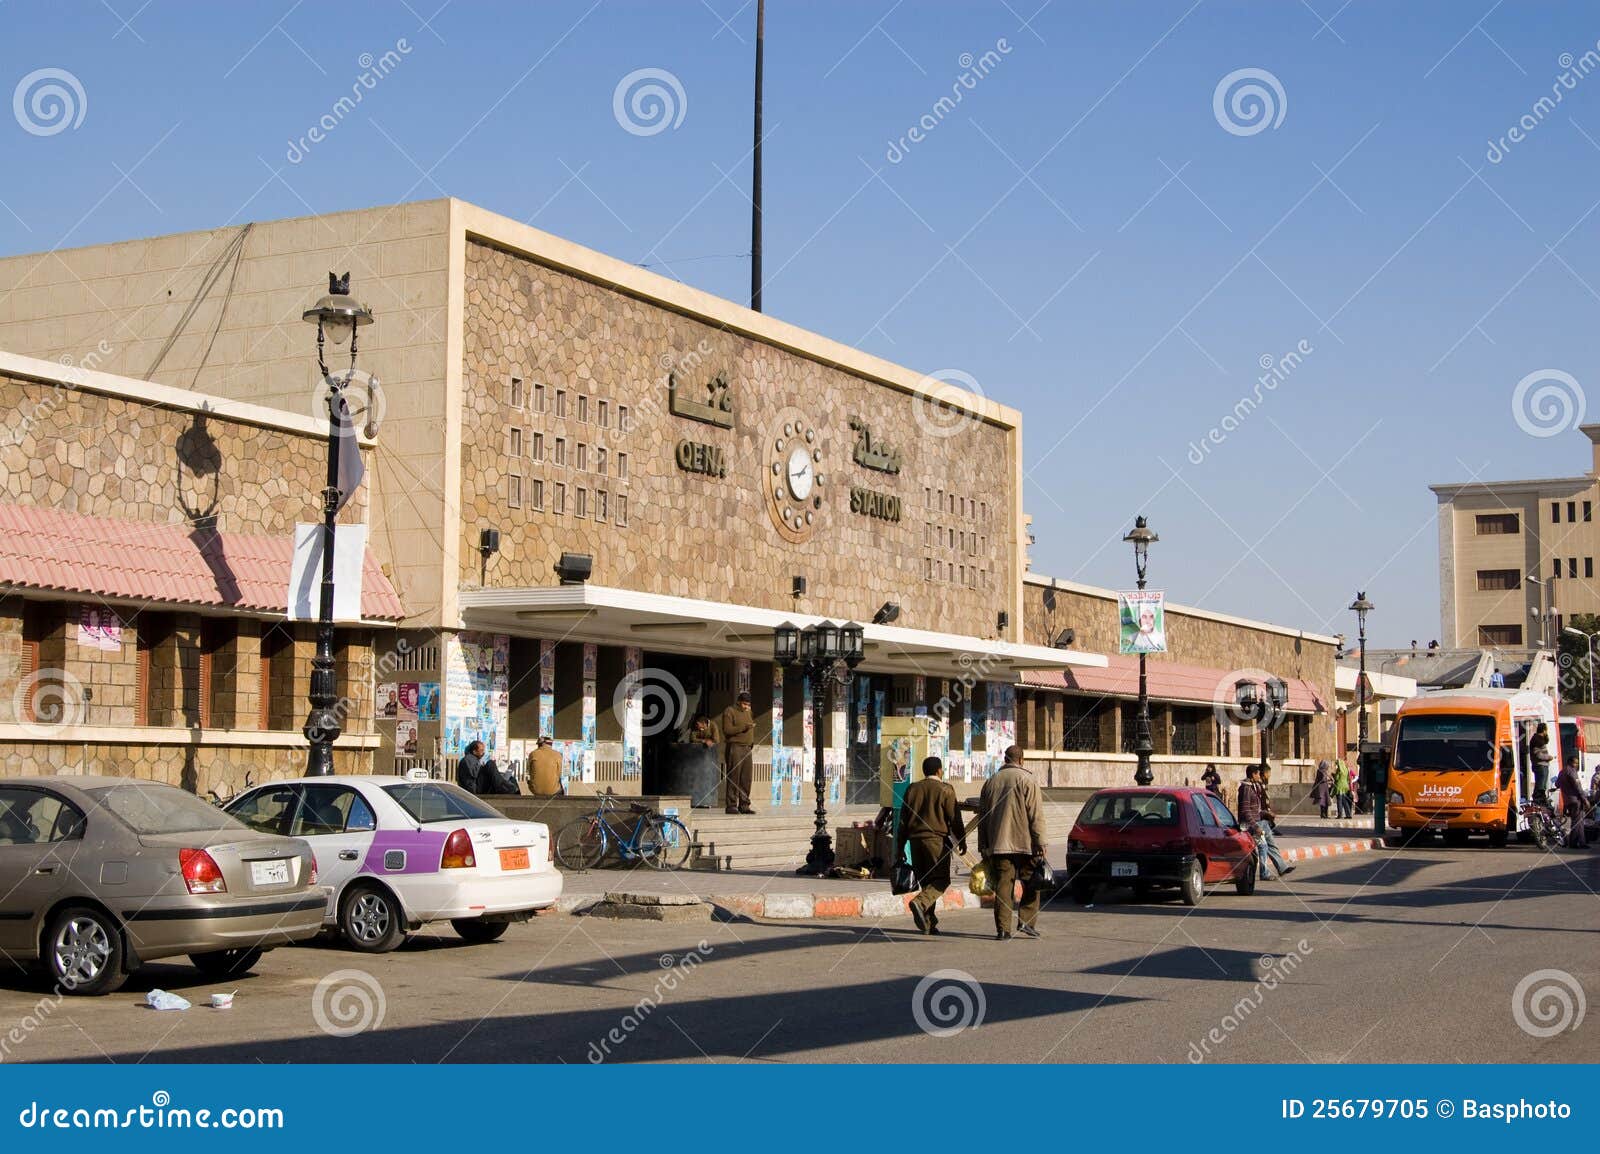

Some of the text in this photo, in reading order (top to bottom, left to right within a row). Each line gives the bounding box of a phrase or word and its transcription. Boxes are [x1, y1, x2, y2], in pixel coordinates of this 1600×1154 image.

[676, 438, 727, 479] QENA
[850, 486, 900, 523] STATION
[1418, 783, 1462, 798] موبينيل
